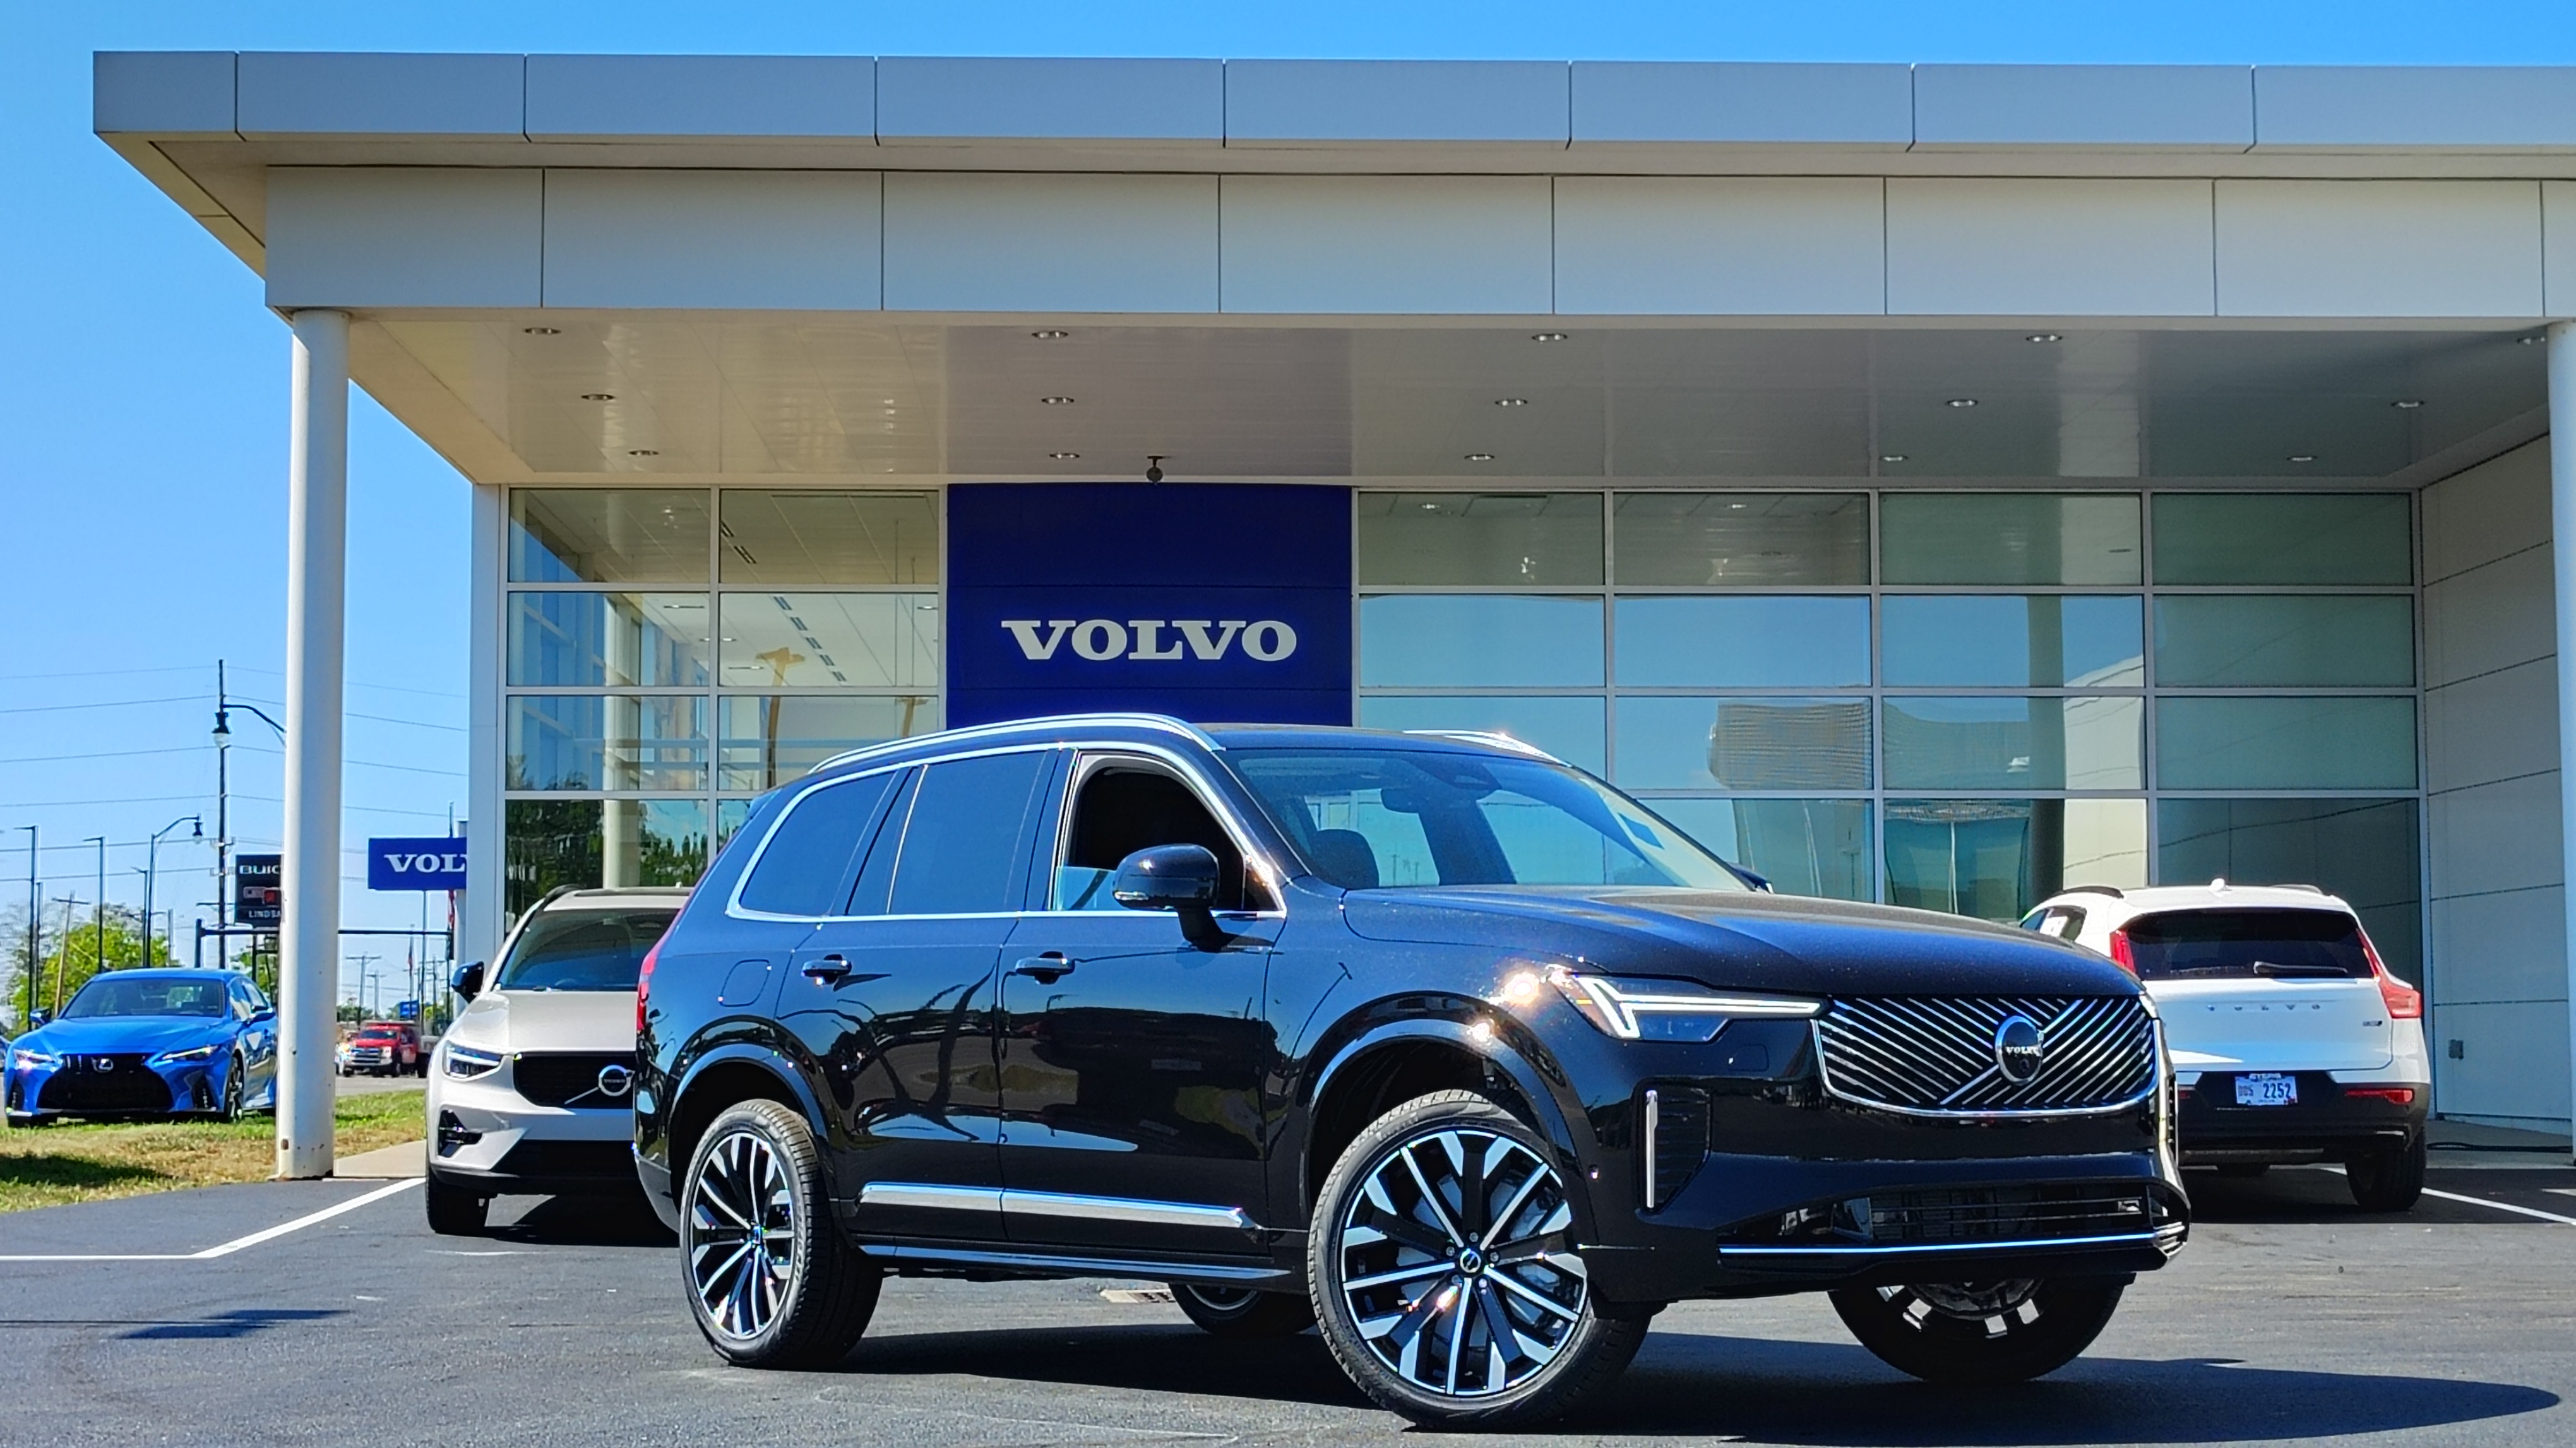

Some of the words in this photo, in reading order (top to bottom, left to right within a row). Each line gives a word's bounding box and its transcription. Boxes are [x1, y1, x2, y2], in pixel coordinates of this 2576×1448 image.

[1001, 619, 1297, 662] VOLVO
[239, 865, 281, 875] BUIC
[383, 853, 467, 873] VOL
[248, 910, 281, 918] LINDSA
[2263, 1082, 2291, 1099] 2252
